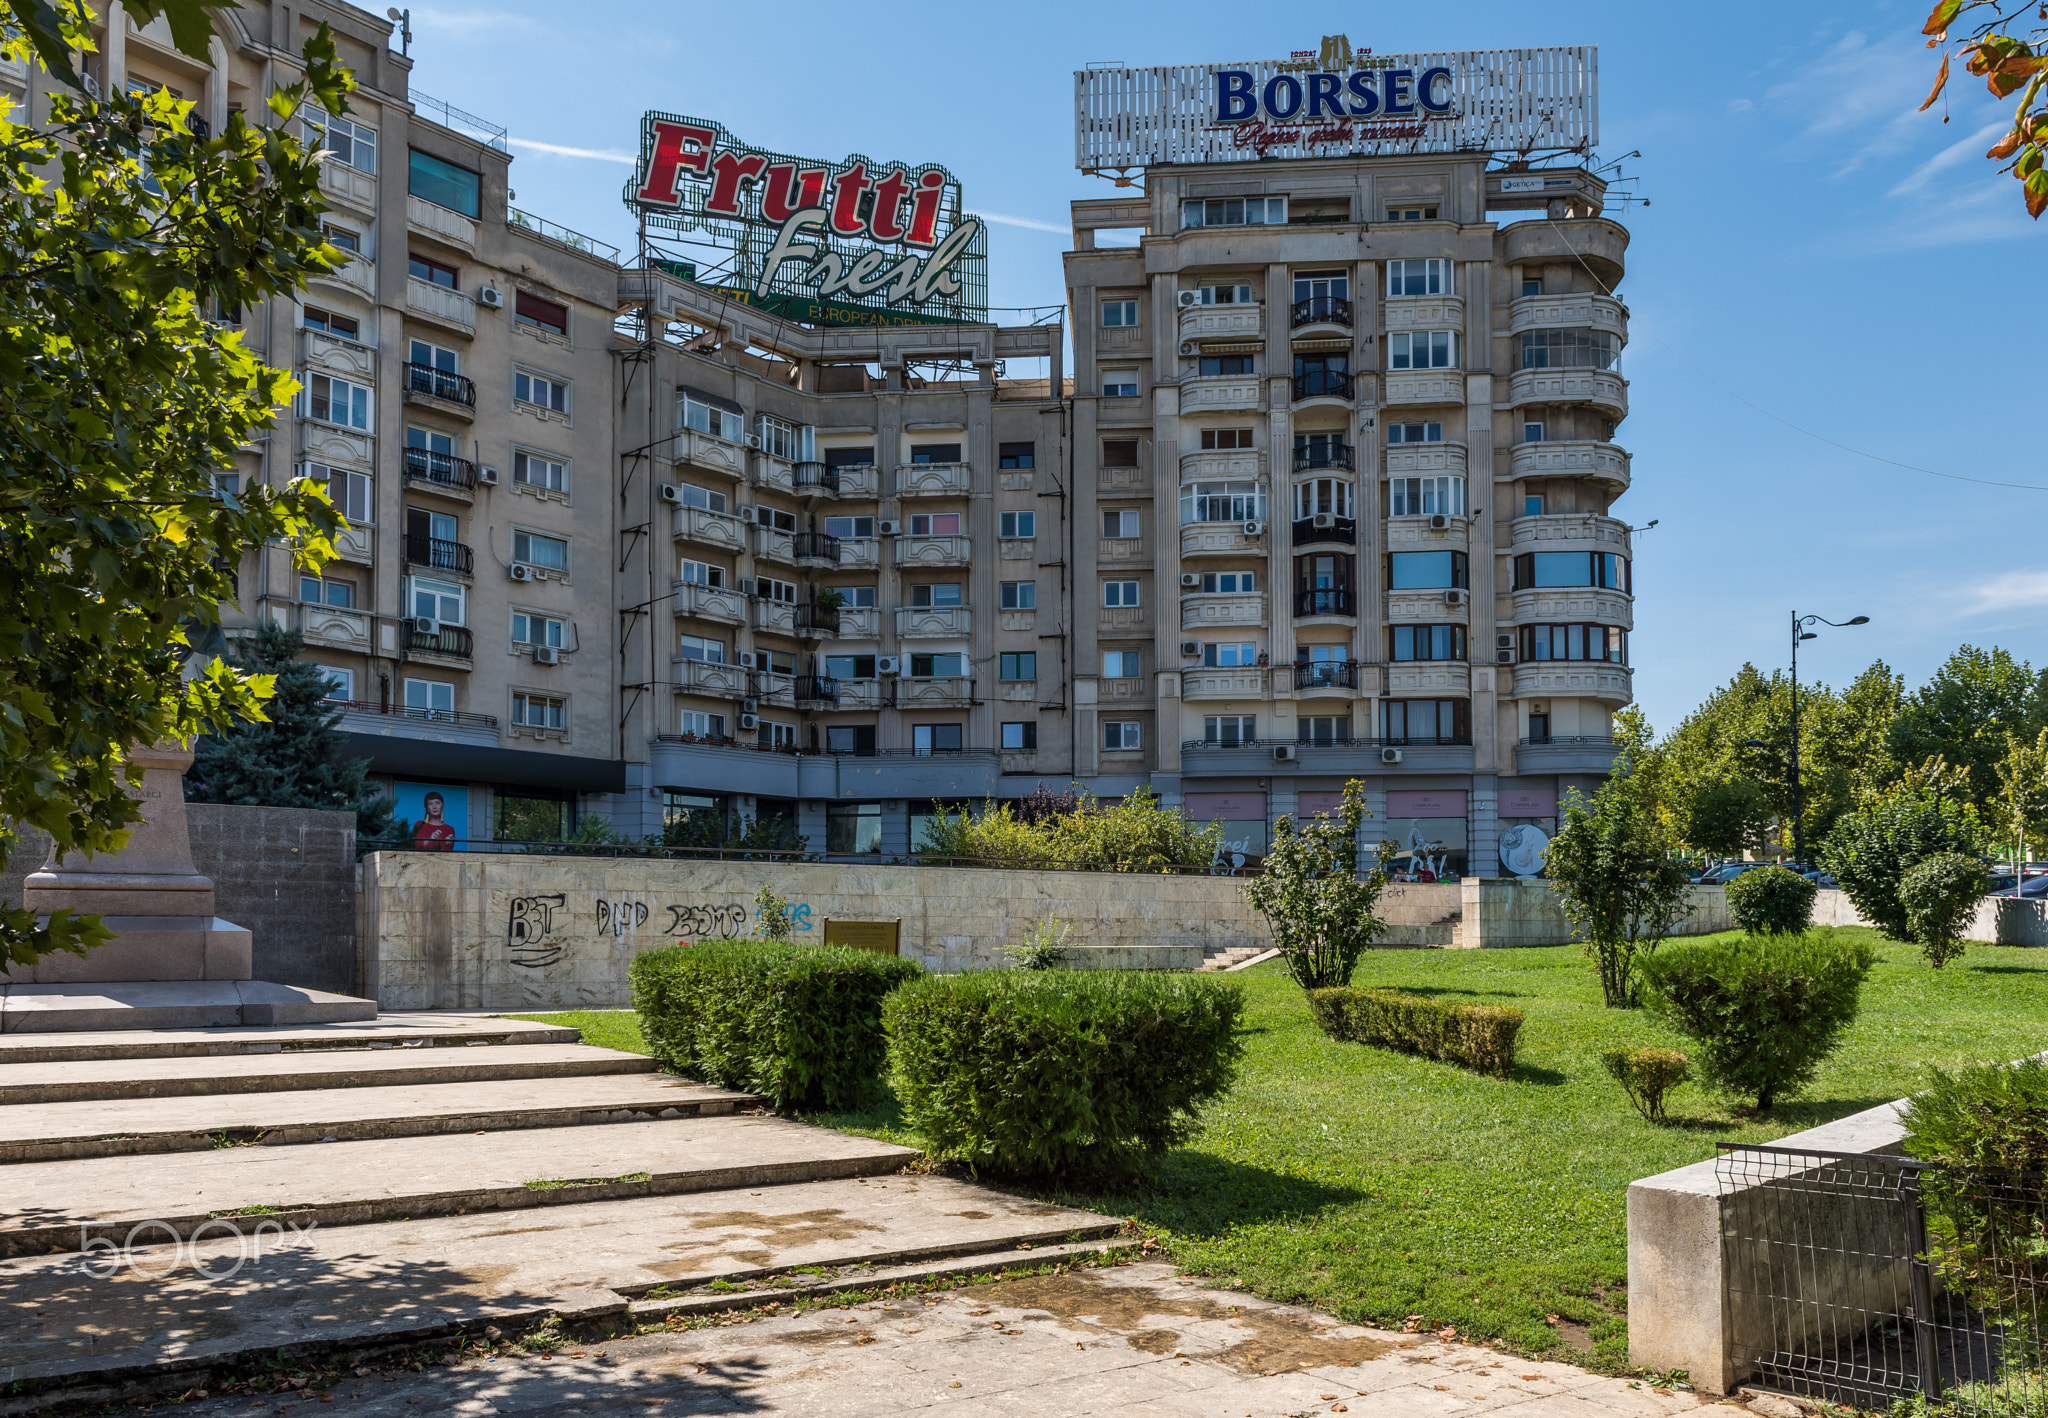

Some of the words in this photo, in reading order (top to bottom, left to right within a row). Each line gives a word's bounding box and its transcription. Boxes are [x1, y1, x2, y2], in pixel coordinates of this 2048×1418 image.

[1213, 67, 1452, 123] BORSEC
[635, 118, 947, 247] Frutti
[755, 207, 978, 306] Fresh
[809, 305, 889, 327] EUROPEAN
